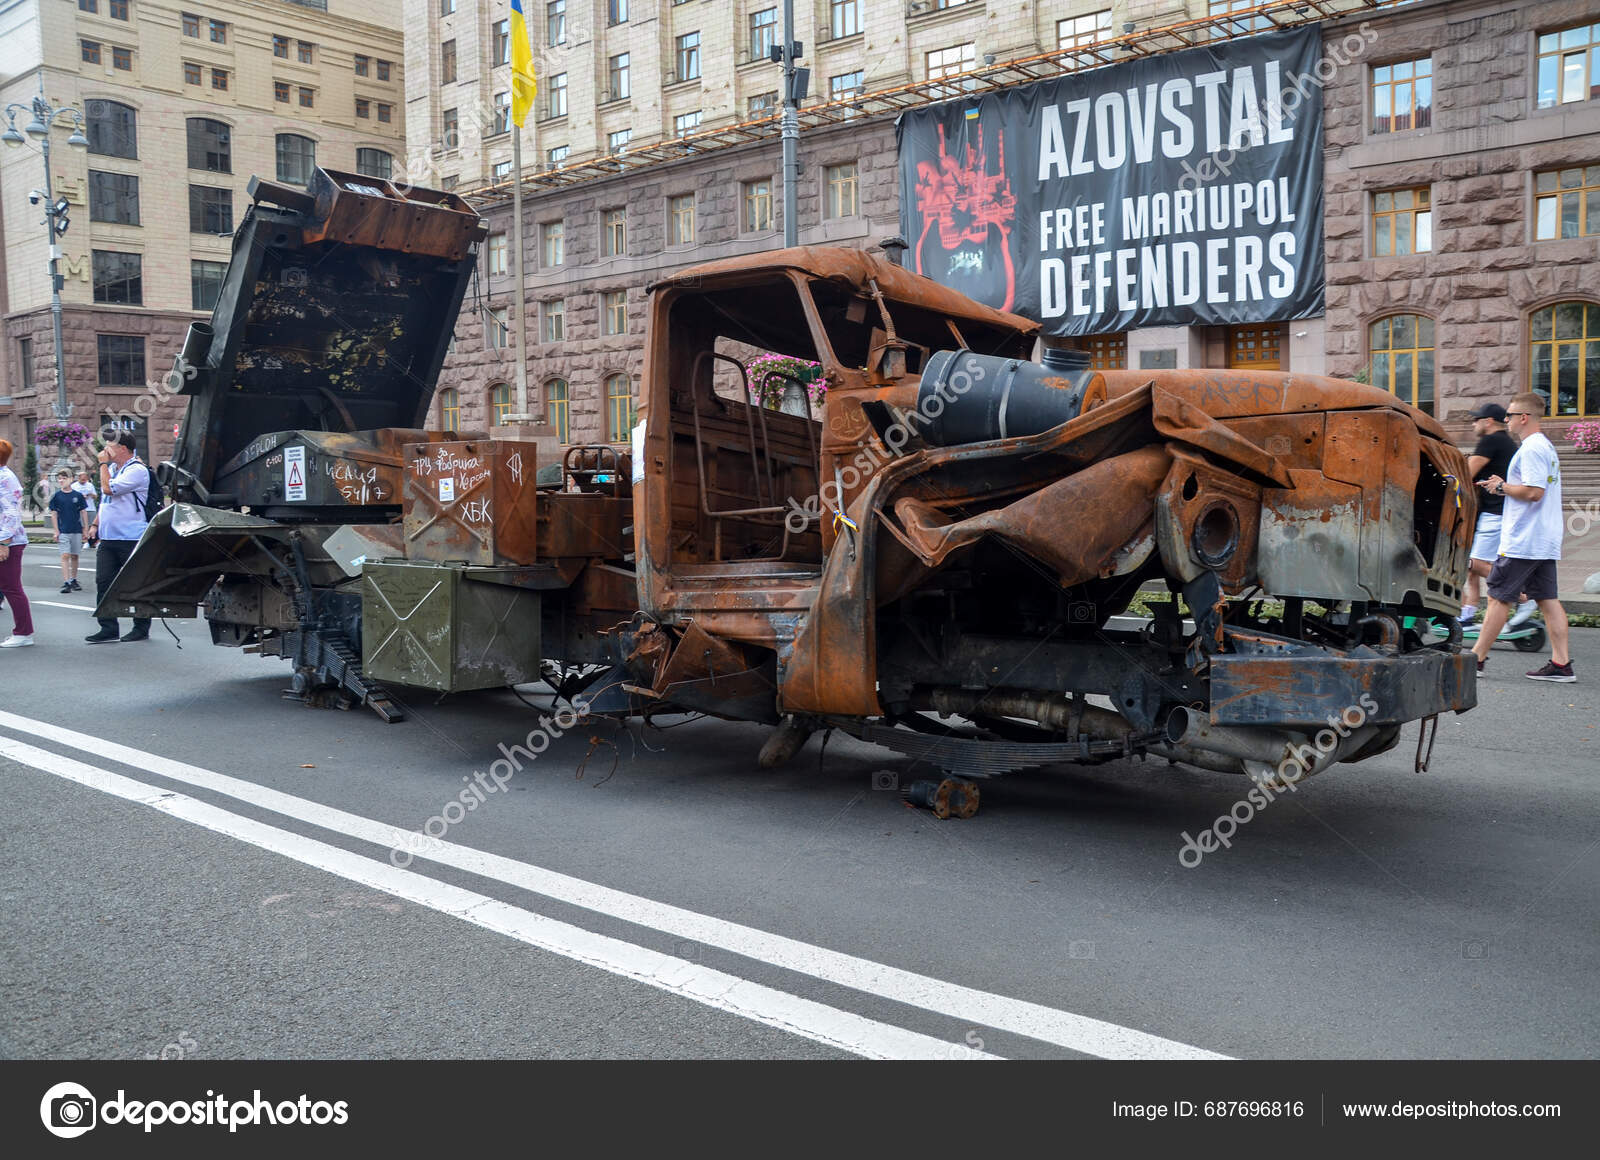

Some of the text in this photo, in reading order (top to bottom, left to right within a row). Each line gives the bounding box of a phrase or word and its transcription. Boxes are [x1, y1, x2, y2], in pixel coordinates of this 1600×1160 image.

[1038, 60, 1294, 181] AZOVSTAL
[1040, 177, 1296, 252] FREE MARIUPOL
[1040, 232, 1297, 319] DEFENDERS
[111, 420, 136, 431] ELLE
[460, 495, 493, 524] ХБК
